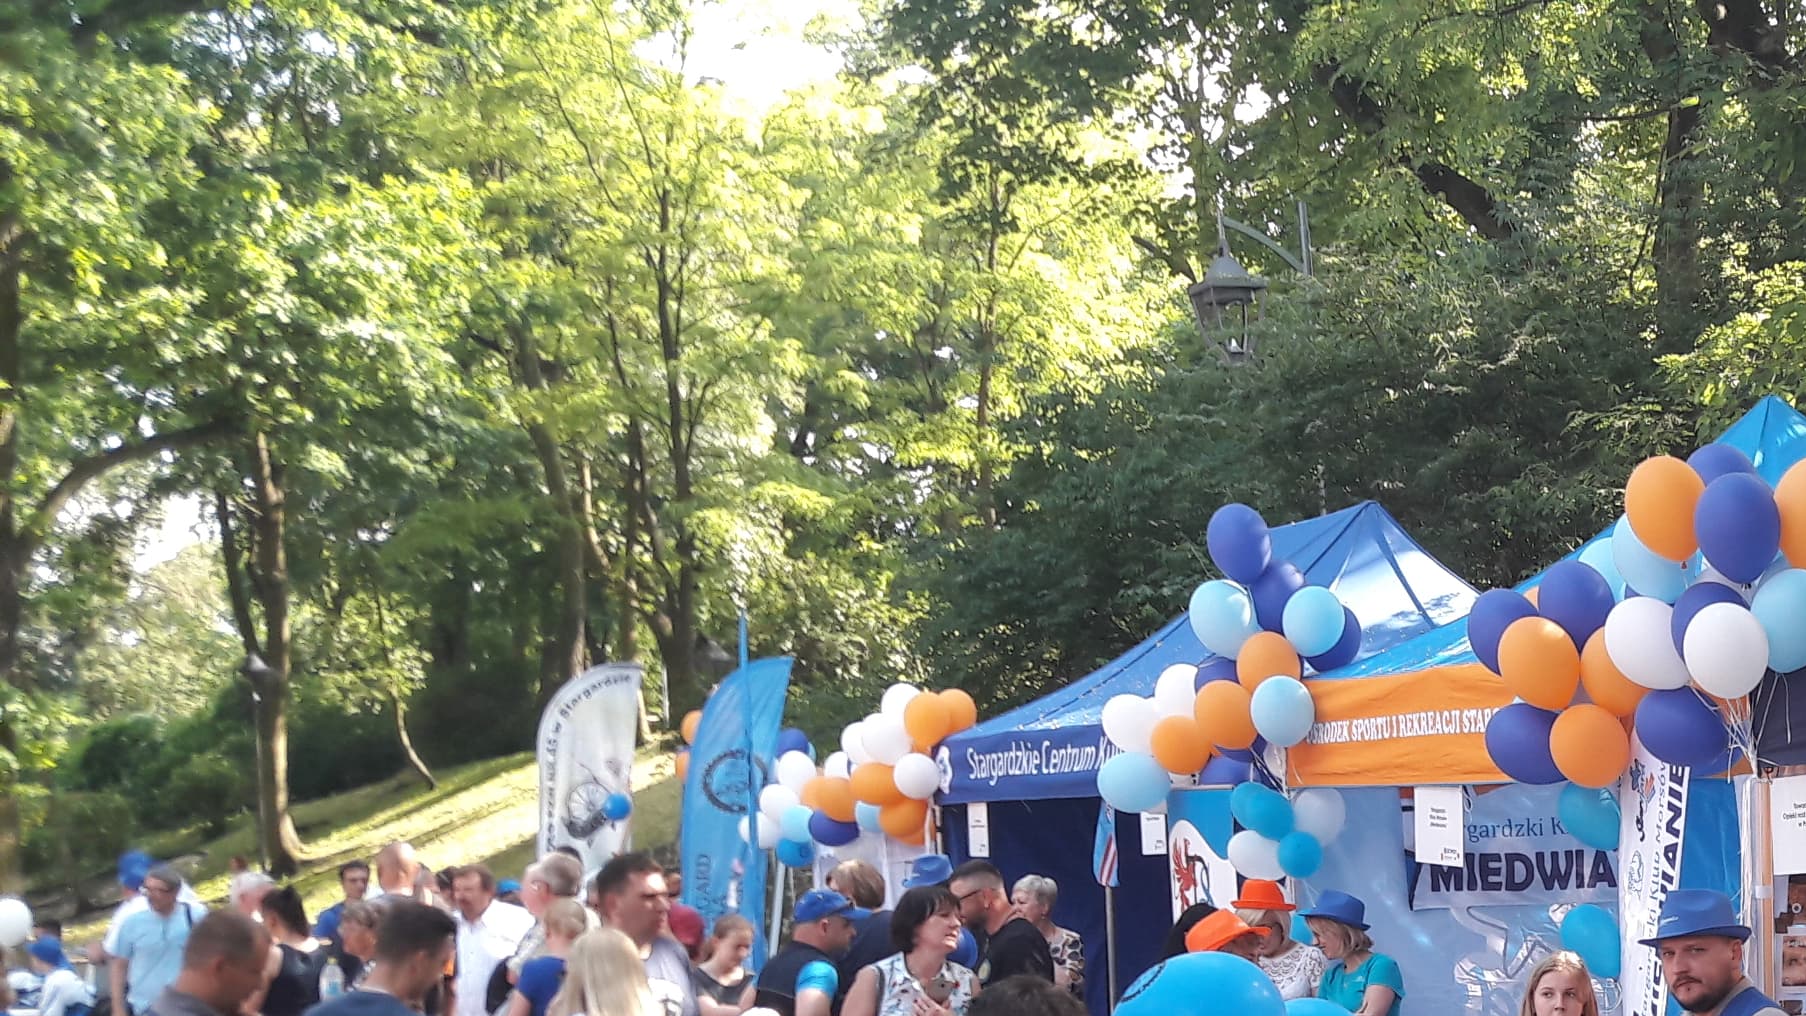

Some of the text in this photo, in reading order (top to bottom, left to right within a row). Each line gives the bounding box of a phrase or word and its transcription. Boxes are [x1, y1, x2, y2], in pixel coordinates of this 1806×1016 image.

[1351, 715, 1390, 742] SPORTU
[1399, 710, 1460, 738] REKREACJI
[1462, 707, 1499, 733] STAR
[966, 741, 1040, 786] Stargardzkie
[1041, 740, 1096, 775] Centrum
[1464, 817, 1544, 843] gardzki
[1430, 848, 1618, 893] MIEDWIA
